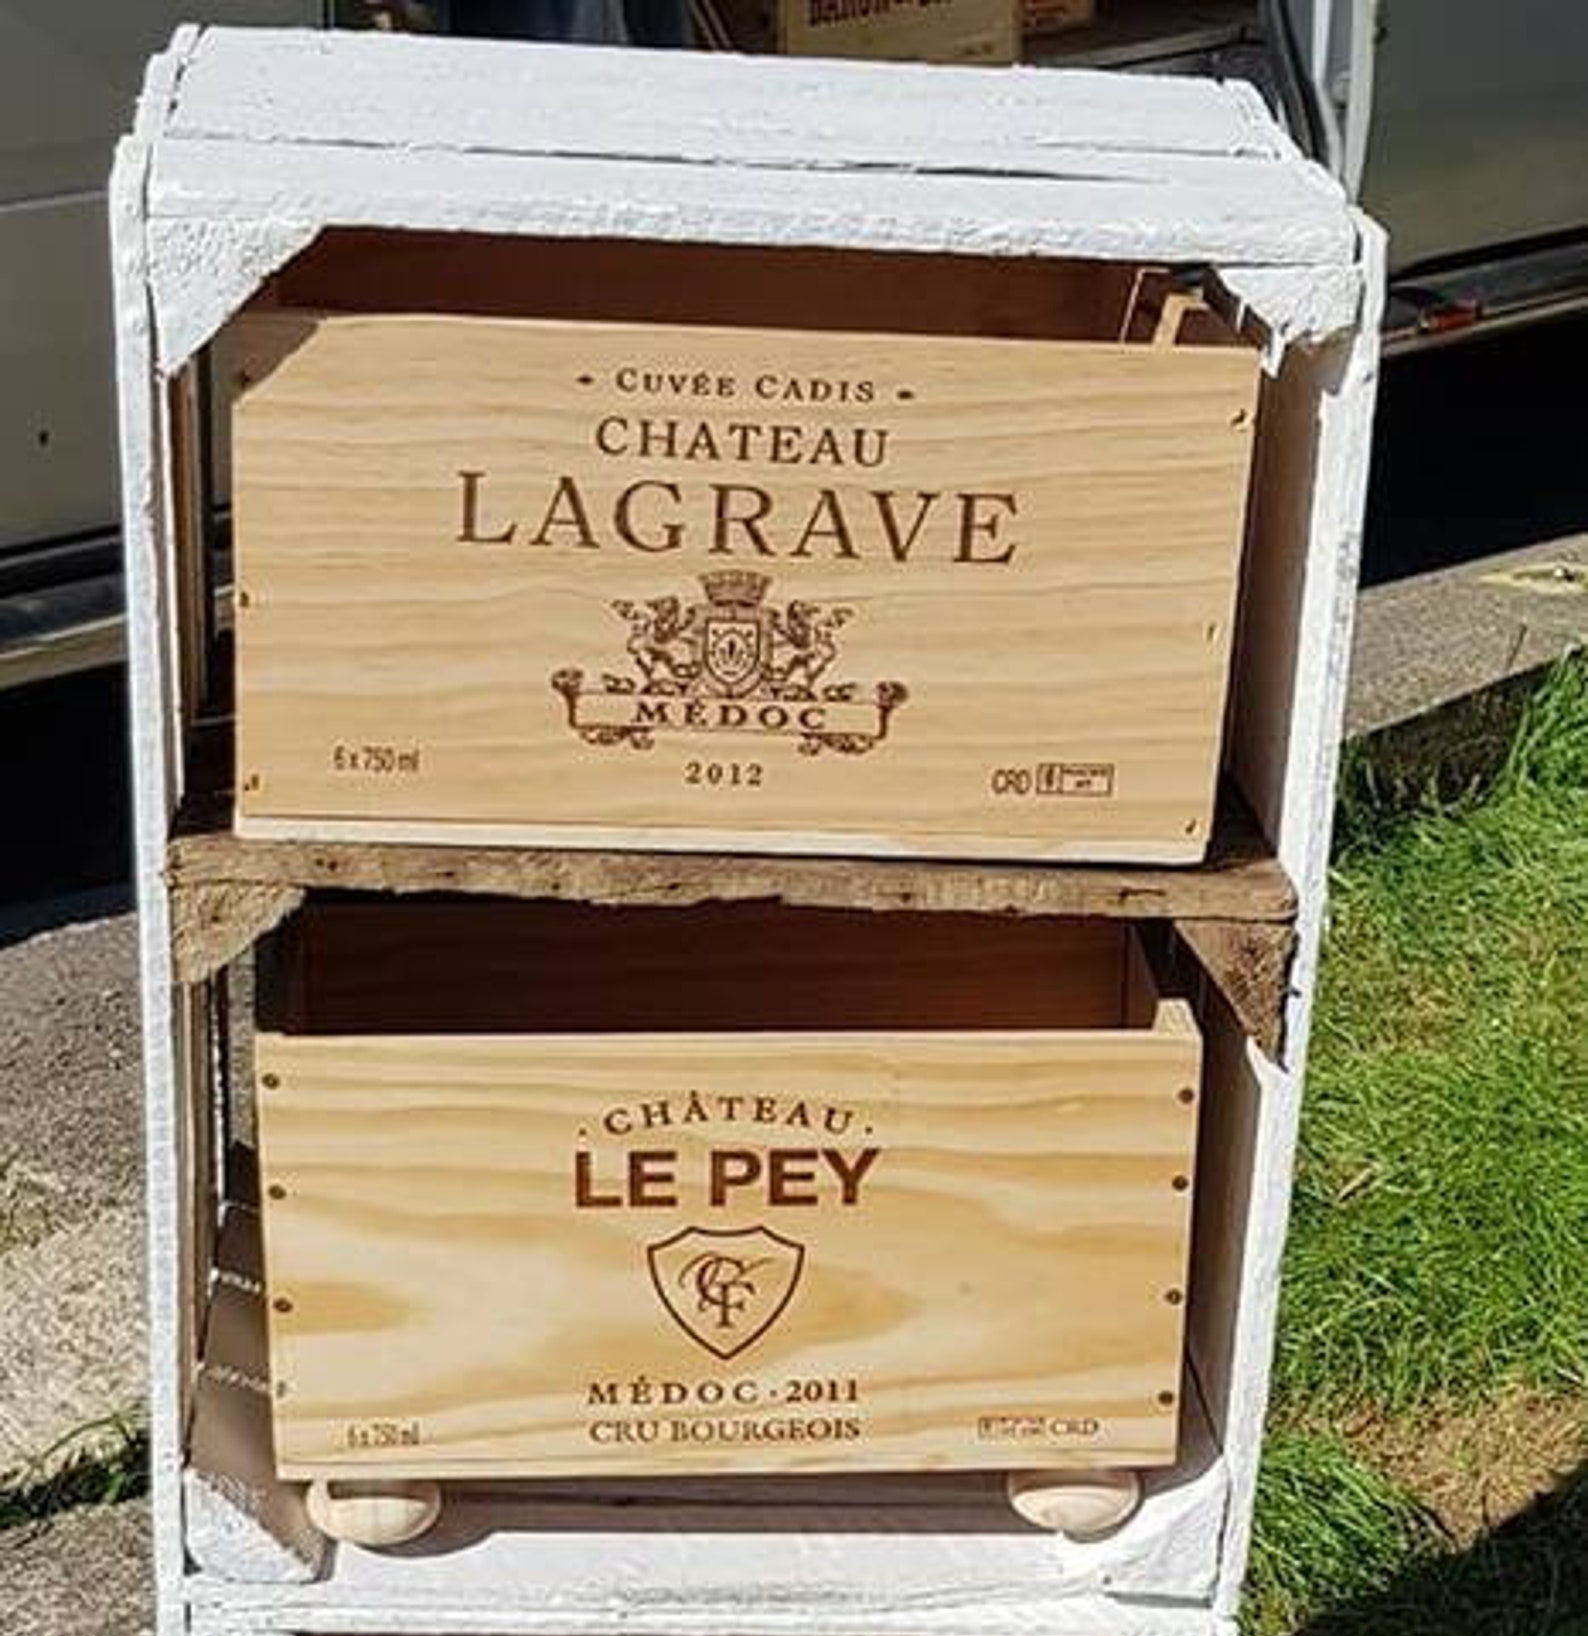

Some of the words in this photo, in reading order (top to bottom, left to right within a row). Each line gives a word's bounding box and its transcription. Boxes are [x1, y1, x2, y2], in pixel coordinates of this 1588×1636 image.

[616, 368, 734, 397] CUVÉE
[755, 375, 874, 402] CADIS
[596, 416, 887, 467] CHATEAU
[457, 471, 1017, 565] LAGRAVE
[630, 699, 826, 729] MÉDOC
[686, 762, 762, 786] 2012
[604, 1090, 854, 1135] CHÂTEAU
[575, 1150, 677, 1208] LE
[710, 1148, 881, 1207] PEY
[589, 1421, 658, 1442] CRU
[671, 1418, 860, 1442] BOURGEOIS
